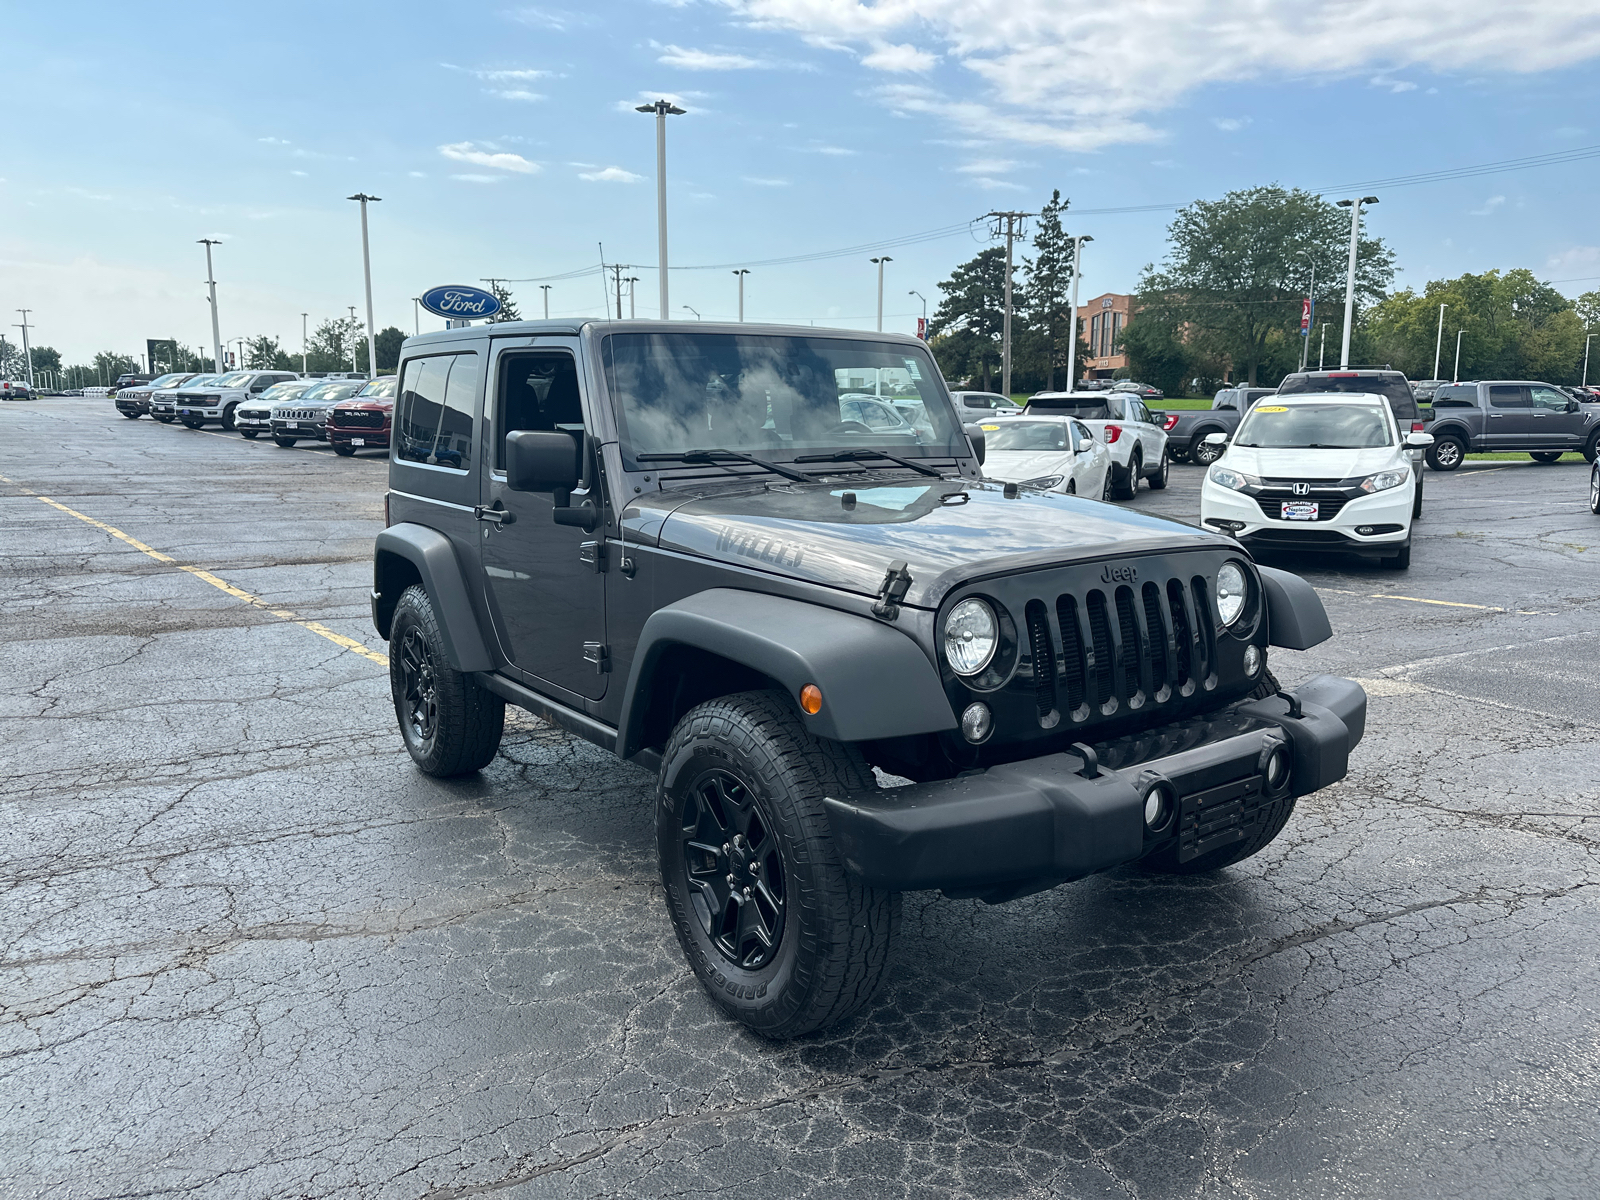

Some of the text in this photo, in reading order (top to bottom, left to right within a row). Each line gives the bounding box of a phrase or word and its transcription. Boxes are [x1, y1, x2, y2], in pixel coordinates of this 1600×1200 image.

[440, 291, 485, 312] Ford
[1100, 564, 1139, 584] Jeep
[668, 881, 768, 1000] BRIDGESTONE
